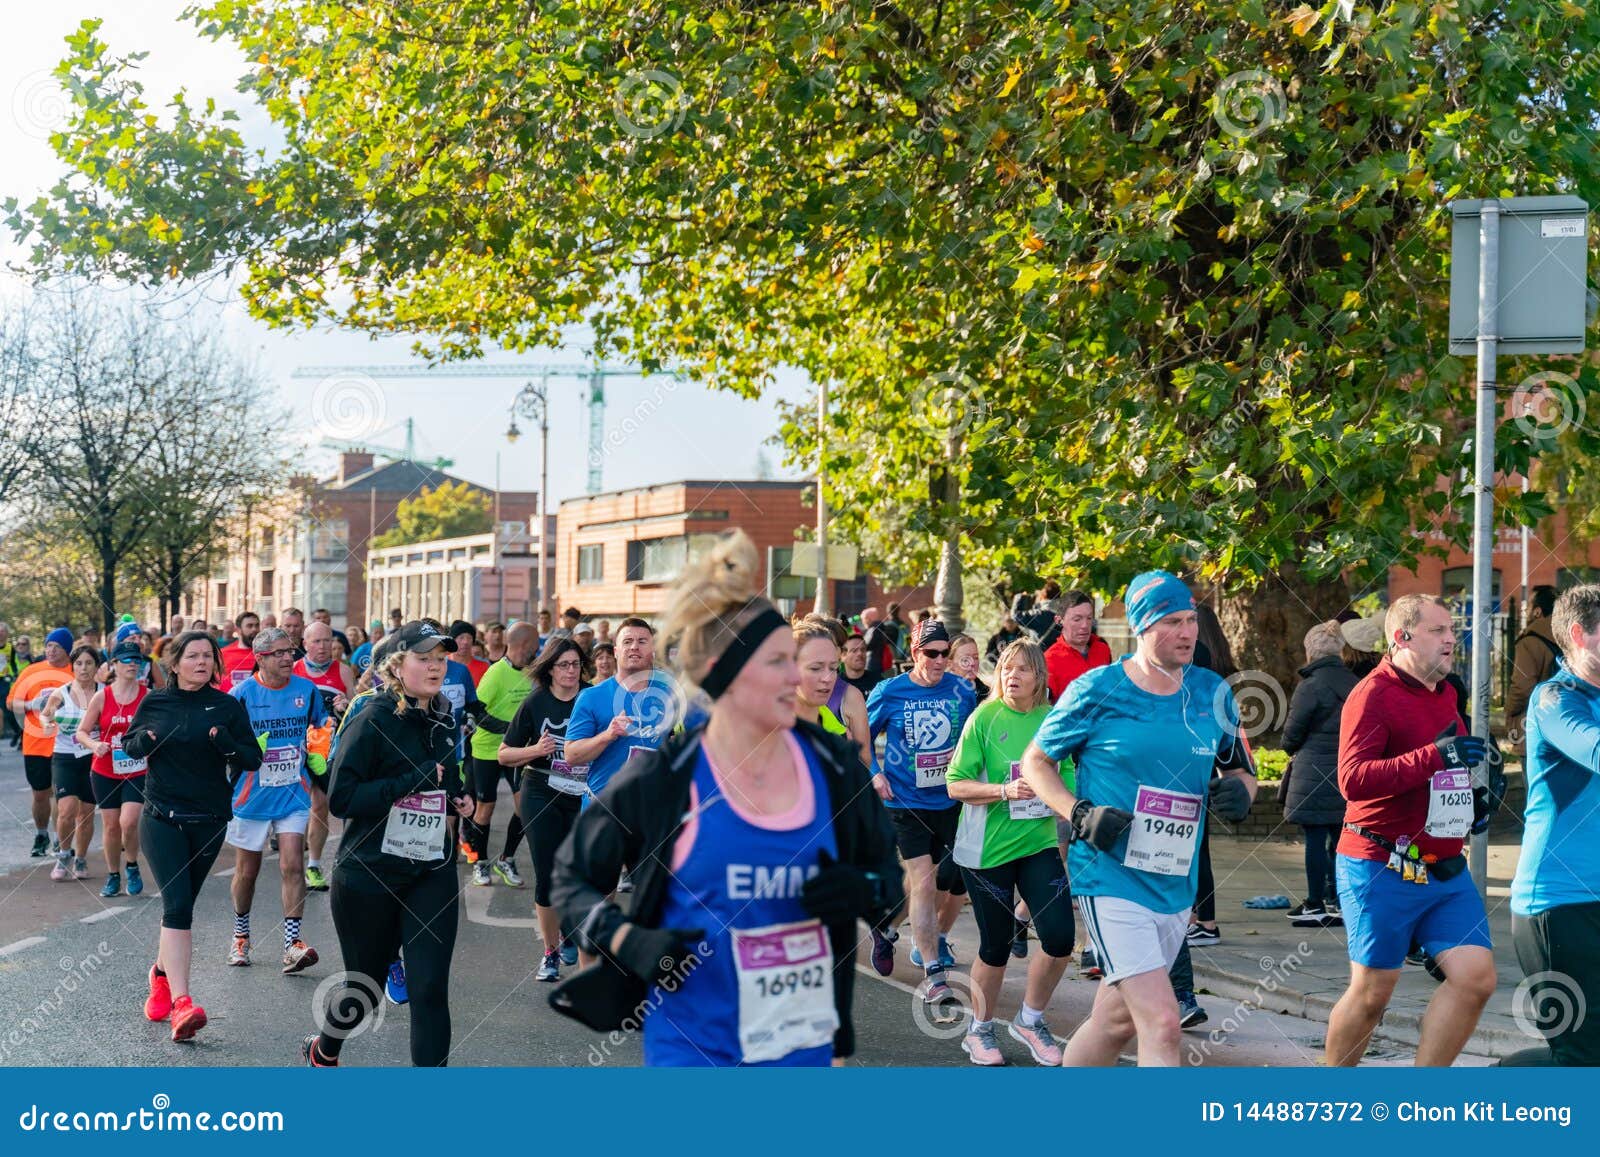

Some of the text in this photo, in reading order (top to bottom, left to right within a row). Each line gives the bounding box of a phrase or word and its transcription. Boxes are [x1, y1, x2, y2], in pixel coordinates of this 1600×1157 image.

[260, 727, 303, 739] ARRIORS
[903, 711, 916, 749] DUBLIN
[1440, 792, 1472, 806] 16205
[400, 811, 442, 829] 17897
[1144, 818, 1194, 840] 19449
[726, 863, 820, 900] EMM
